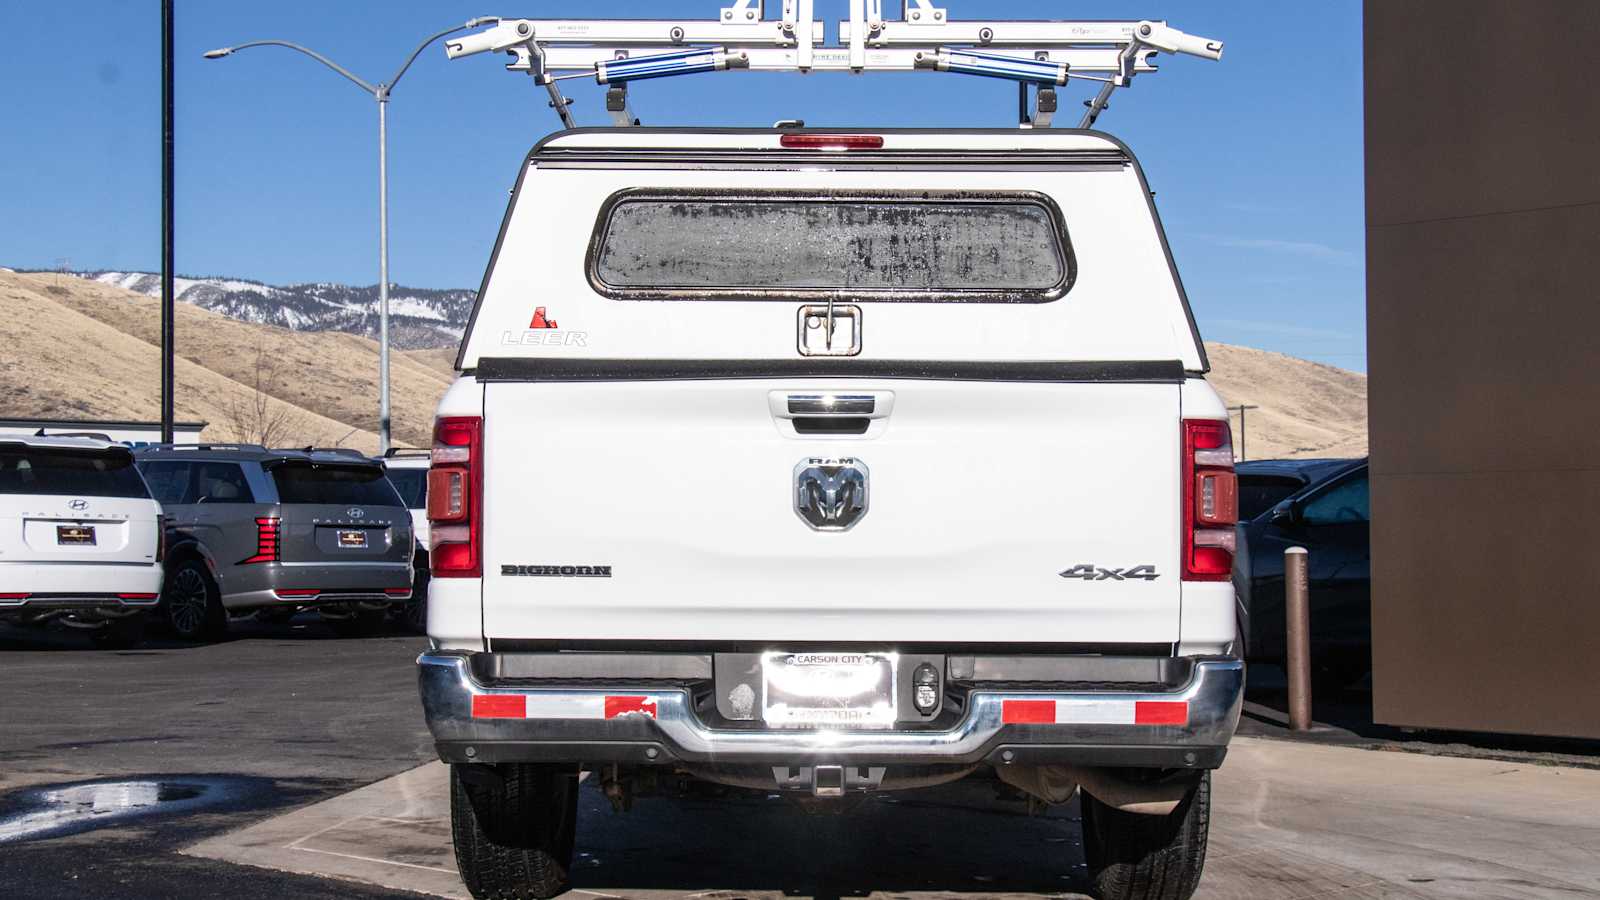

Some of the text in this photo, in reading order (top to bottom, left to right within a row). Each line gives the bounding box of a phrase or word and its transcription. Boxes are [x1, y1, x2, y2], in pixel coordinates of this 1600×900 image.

[500, 330, 588, 347] LEER
[500, 564, 612, 577] BIGHORN
[1058, 564, 1161, 581] 4x4
[796, 655, 863, 664] CARSON CITY
